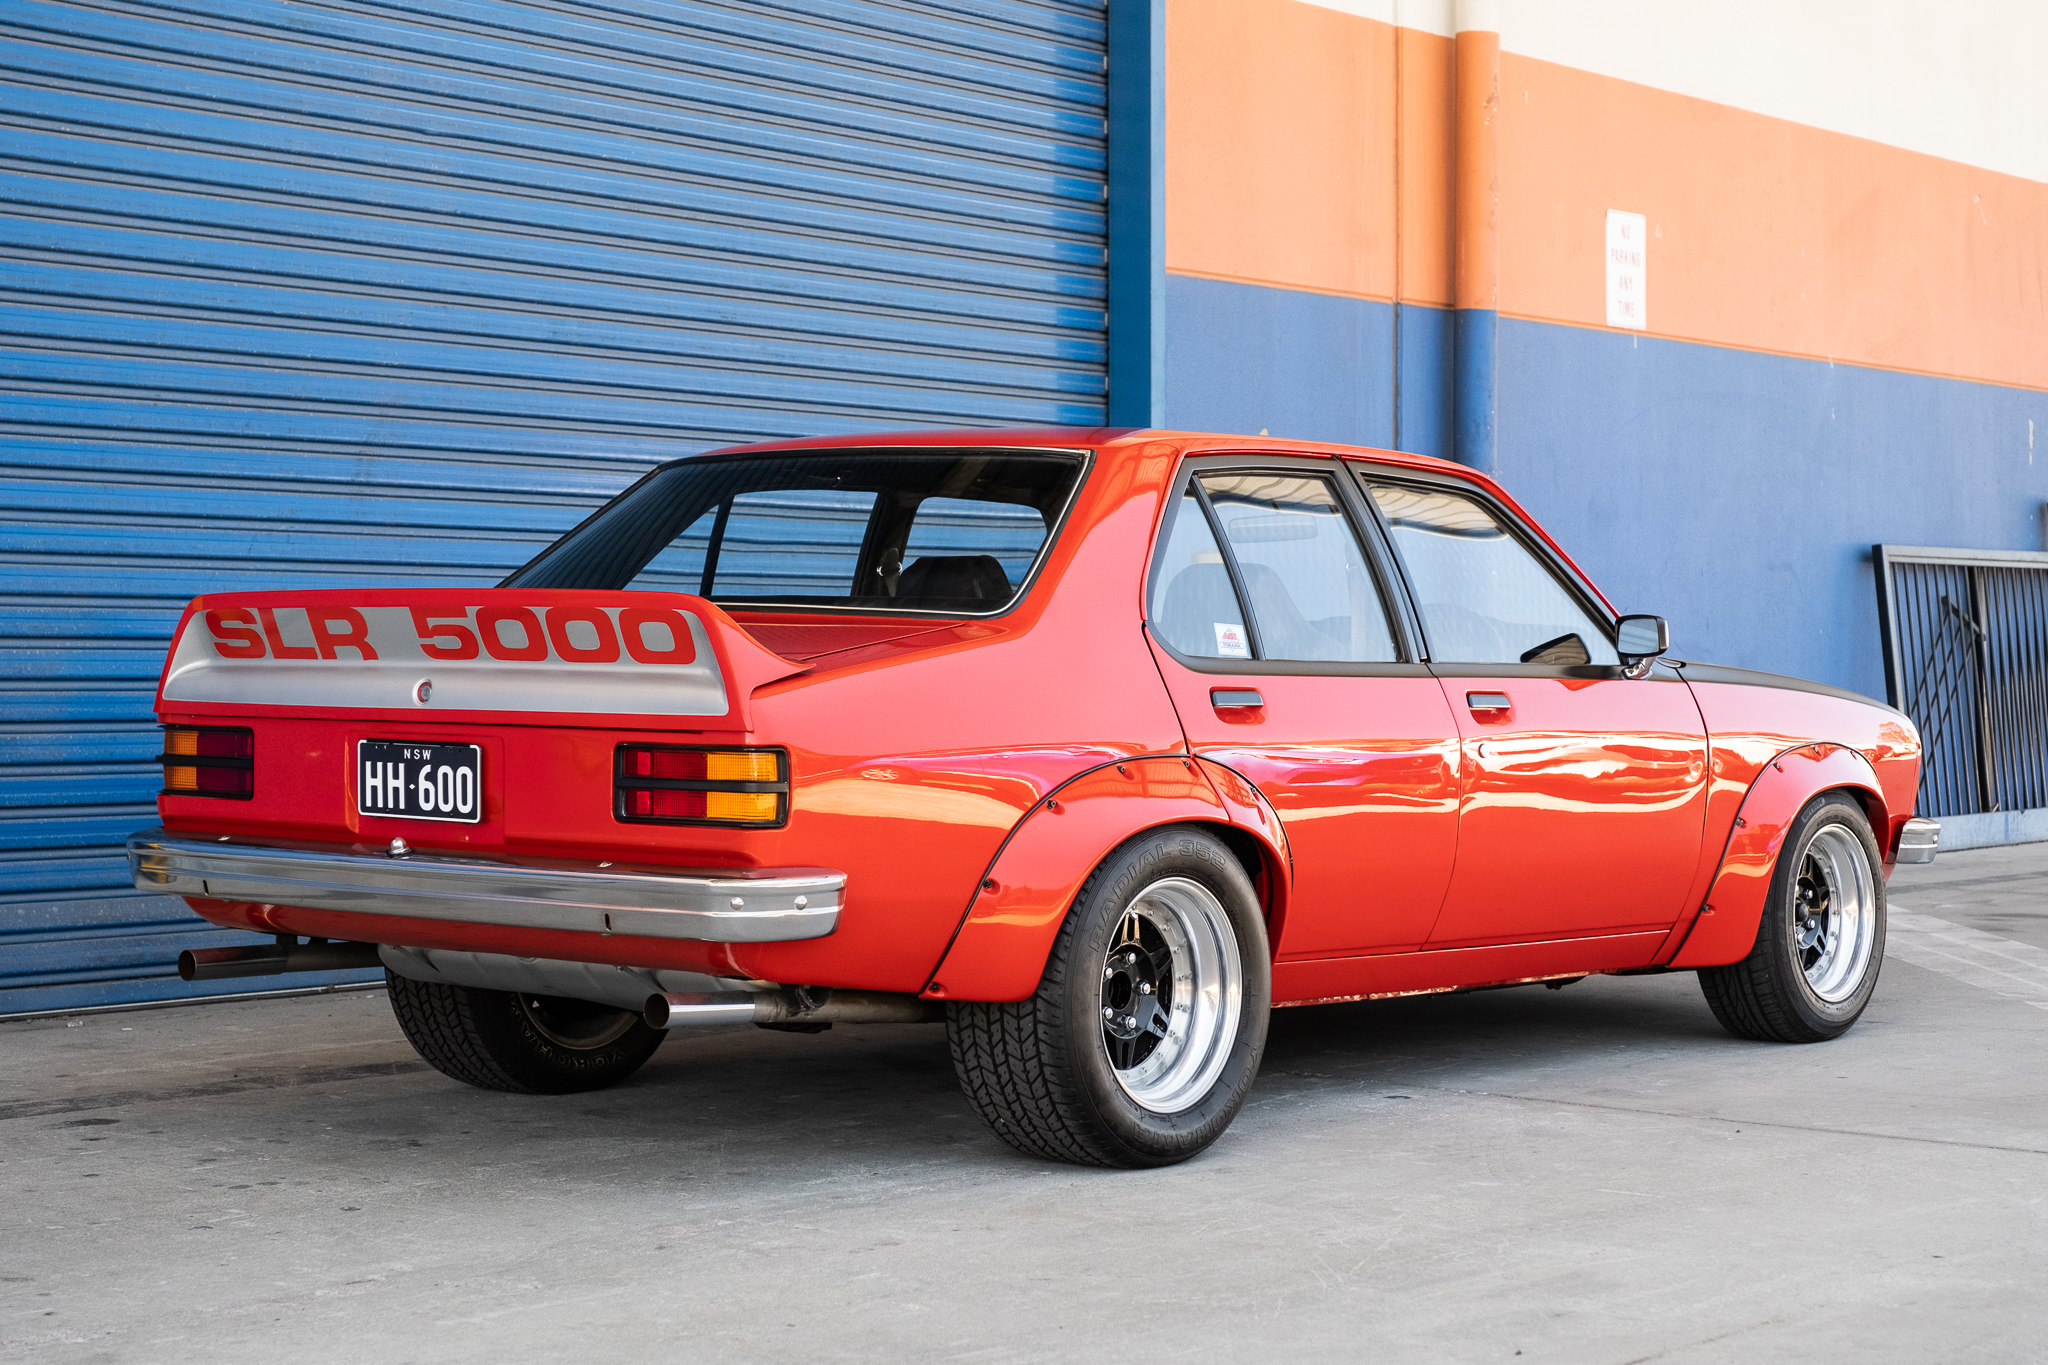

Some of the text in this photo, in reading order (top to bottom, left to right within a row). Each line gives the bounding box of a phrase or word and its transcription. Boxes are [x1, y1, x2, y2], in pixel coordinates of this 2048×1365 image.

[1621, 224, 1631, 240] NO
[1611, 248, 1641, 267] PARKING
[1619, 275, 1633, 291] ANY
[1618, 300, 1635, 317] TIME
[205, 605, 697, 665] SLR 5000
[403, 748, 432, 761] NSW
[1088, 842, 1172, 952] RADIAL
[1179, 838, 1226, 873] 352
[506, 992, 628, 1071] YOKOHAM
[1133, 1043, 1264, 1151] YOKOHAMA
